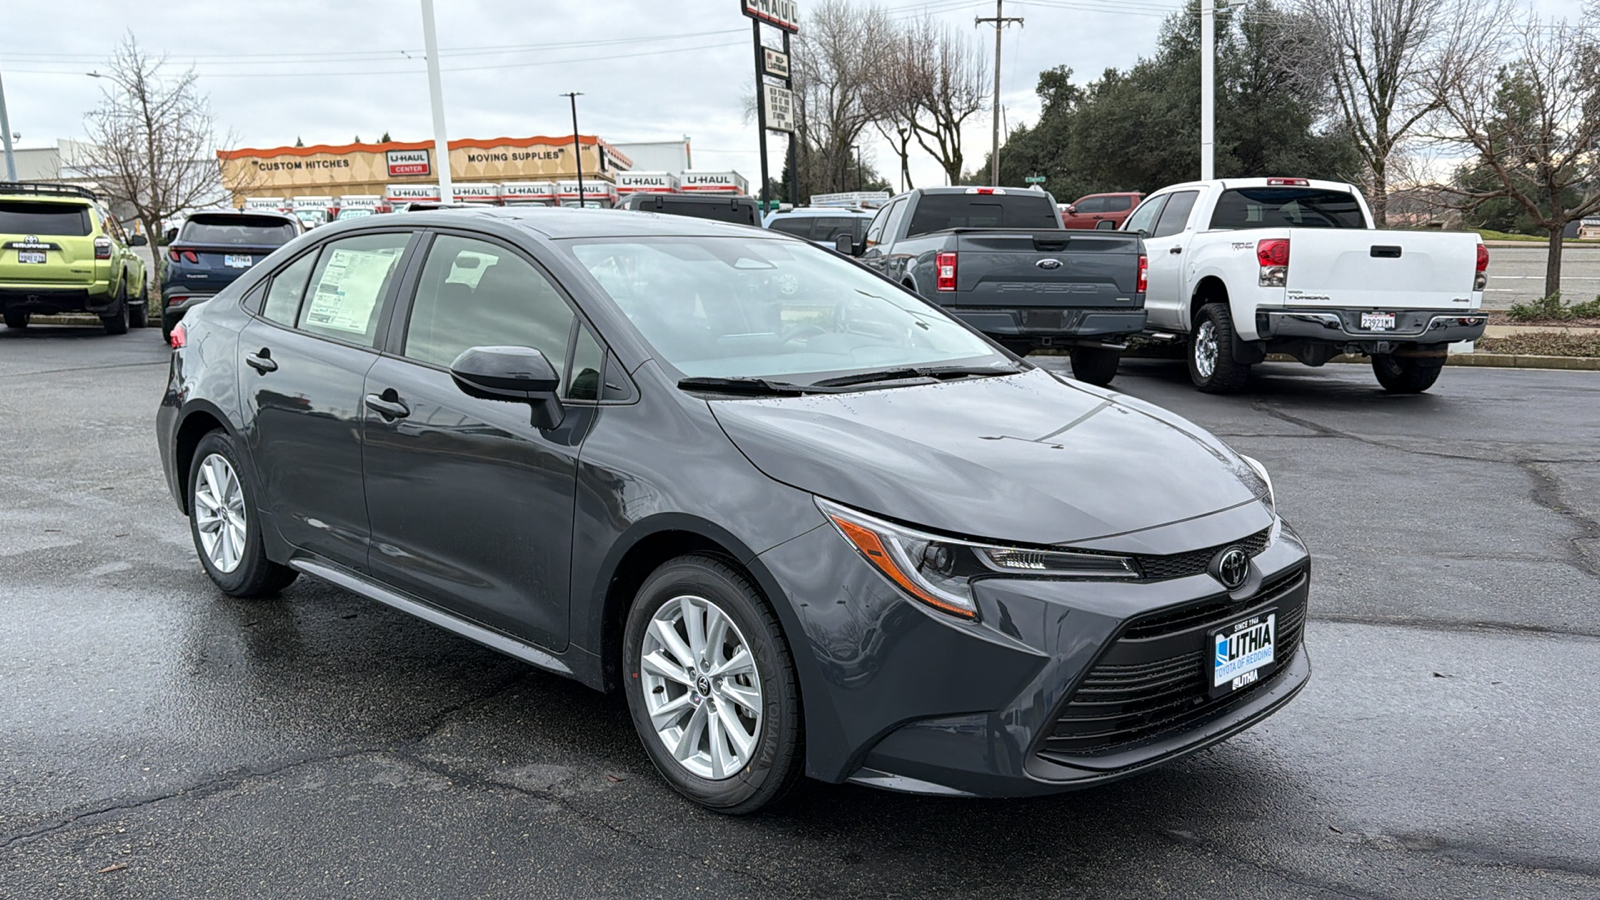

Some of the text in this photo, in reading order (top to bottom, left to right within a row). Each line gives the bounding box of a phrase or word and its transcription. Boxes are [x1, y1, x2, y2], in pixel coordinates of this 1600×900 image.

[390, 154, 425, 162] U-HAUL
[468, 153, 508, 162] MOVING
[306, 159, 350, 168] HITCHES
[395, 165, 423, 173] CENTER
[622, 177, 665, 186] U-HAUL
[687, 176, 731, 184] U-HAUL
[1229, 624, 1271, 661] LITHIA
[1215, 647, 1272, 679] TOYOTA OF REDDING
[1238, 669, 1258, 686] LITHIA
